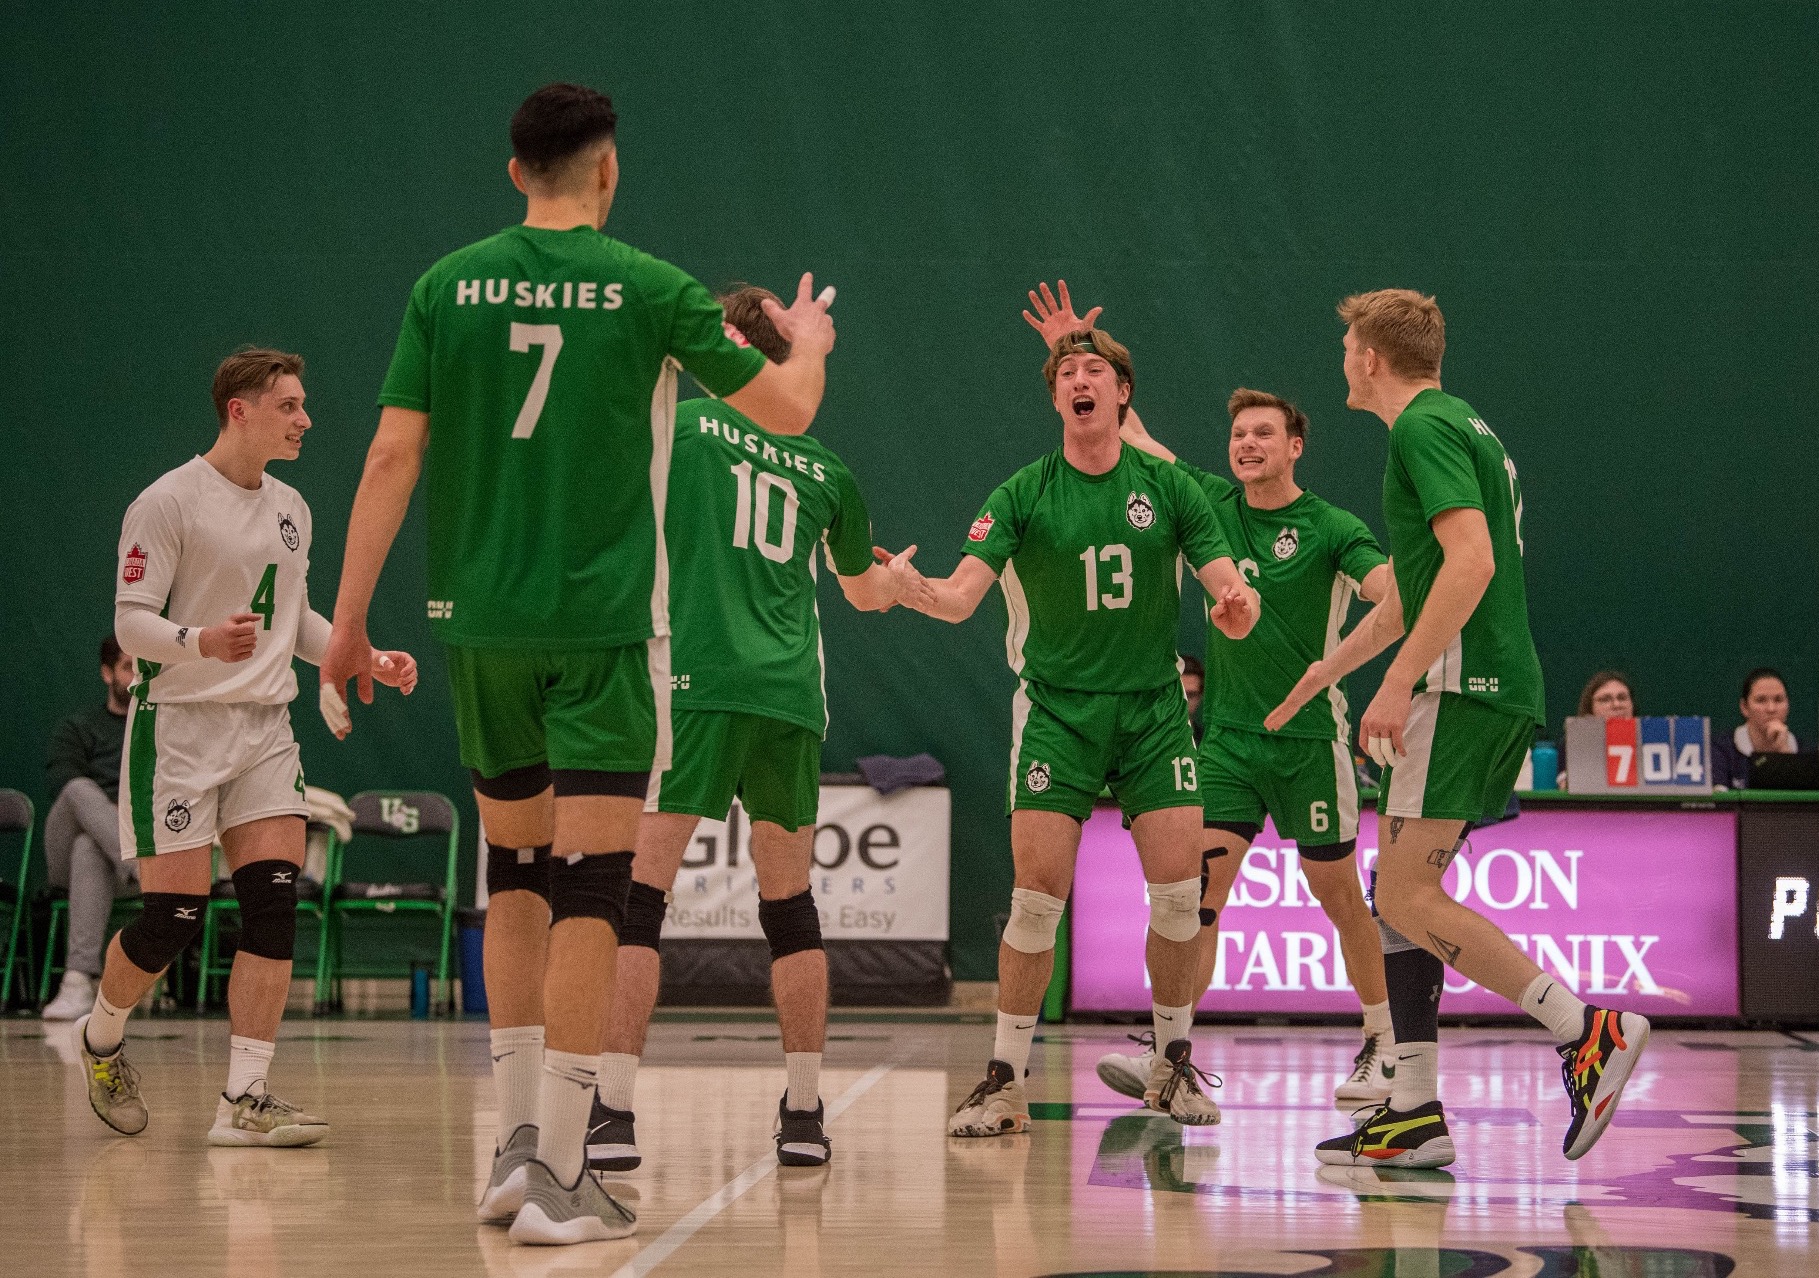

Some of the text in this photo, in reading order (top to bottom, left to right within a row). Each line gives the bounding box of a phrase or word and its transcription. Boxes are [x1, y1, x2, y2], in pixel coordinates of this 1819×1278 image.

[456, 278, 623, 310] HUSKIES
[509, 321, 564, 439] 7
[699, 416, 826, 482] HUSKIES
[730, 460, 800, 564] 10
[250, 564, 278, 631] 4
[1079, 543, 1134, 610] 13
[1171, 756, 1197, 792] 13
[1608, 745, 1633, 783] 7
[1310, 801, 1329, 832] 6
[839, 905, 896, 932] Easy
